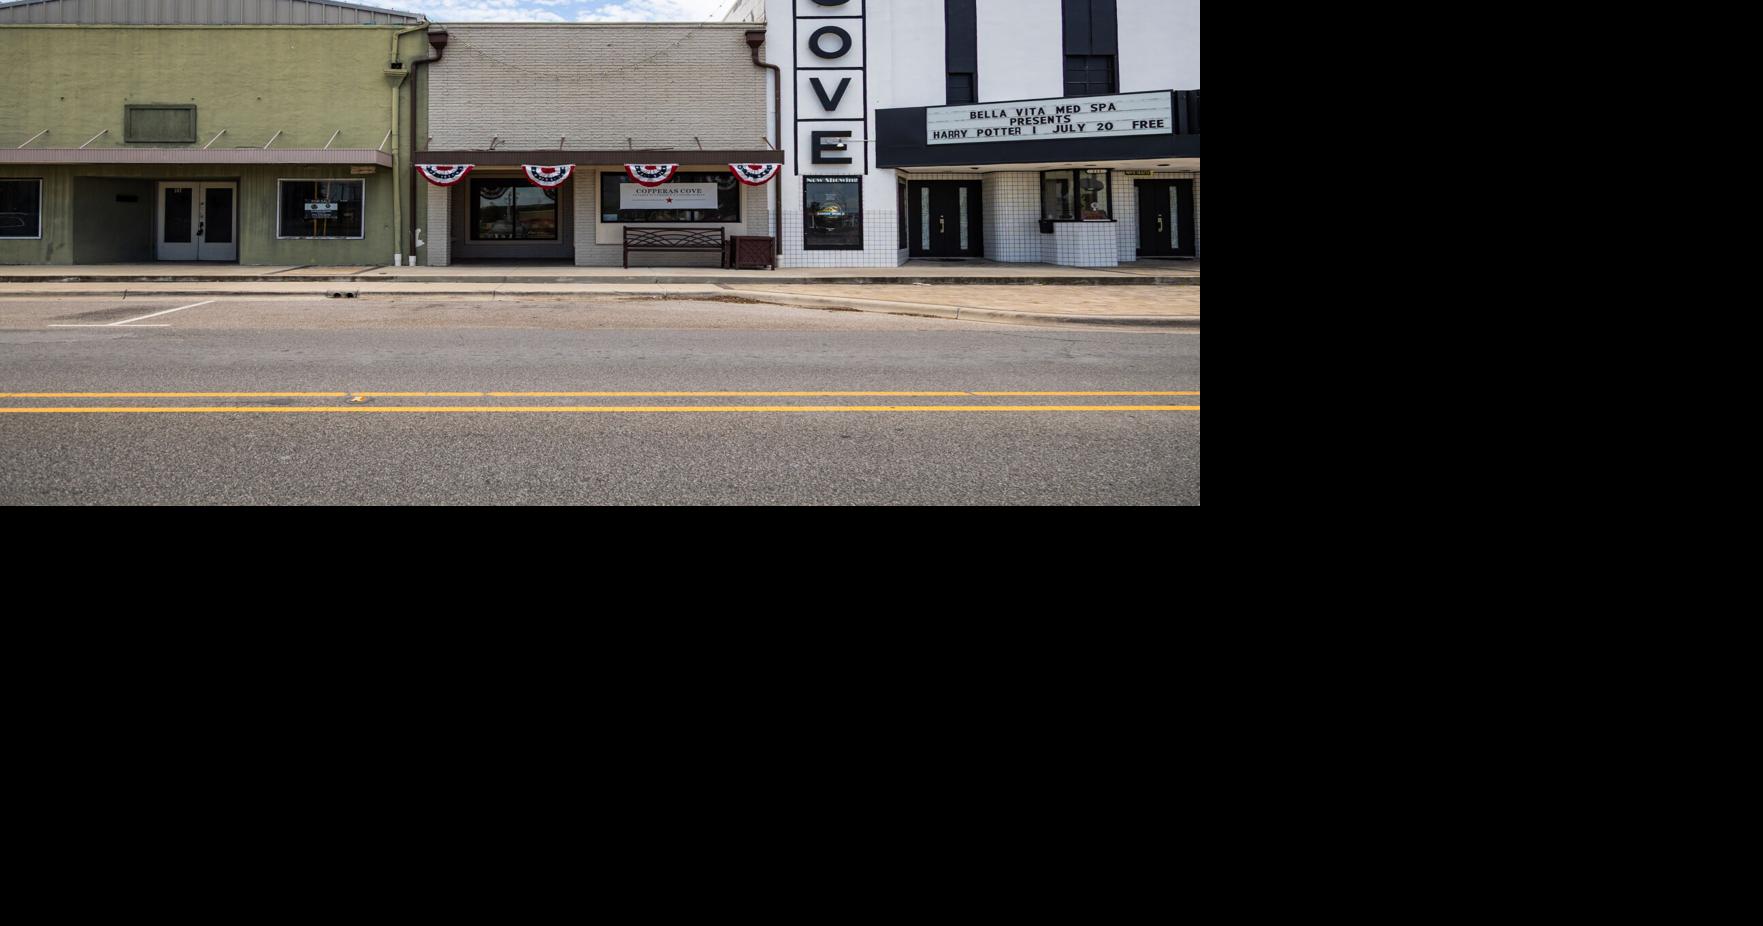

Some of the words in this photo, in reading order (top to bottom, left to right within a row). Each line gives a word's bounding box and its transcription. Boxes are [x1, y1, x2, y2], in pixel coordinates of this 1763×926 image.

[808, 0, 852, 164] OVE
[969, 109, 1007, 120] BELLA
[1016, 107, 1045, 117] VITA
[1055, 105, 1081, 114] MED
[1090, 102, 1116, 112] SPA
[1009, 115, 1071, 126] PRESENTS
[933, 129, 967, 139] HARRY
[976, 127, 1021, 137] POTTER
[1053, 123, 1085, 134] JULY
[1096, 122, 1113, 131] 20
[1132, 119, 1164, 129] FREE
